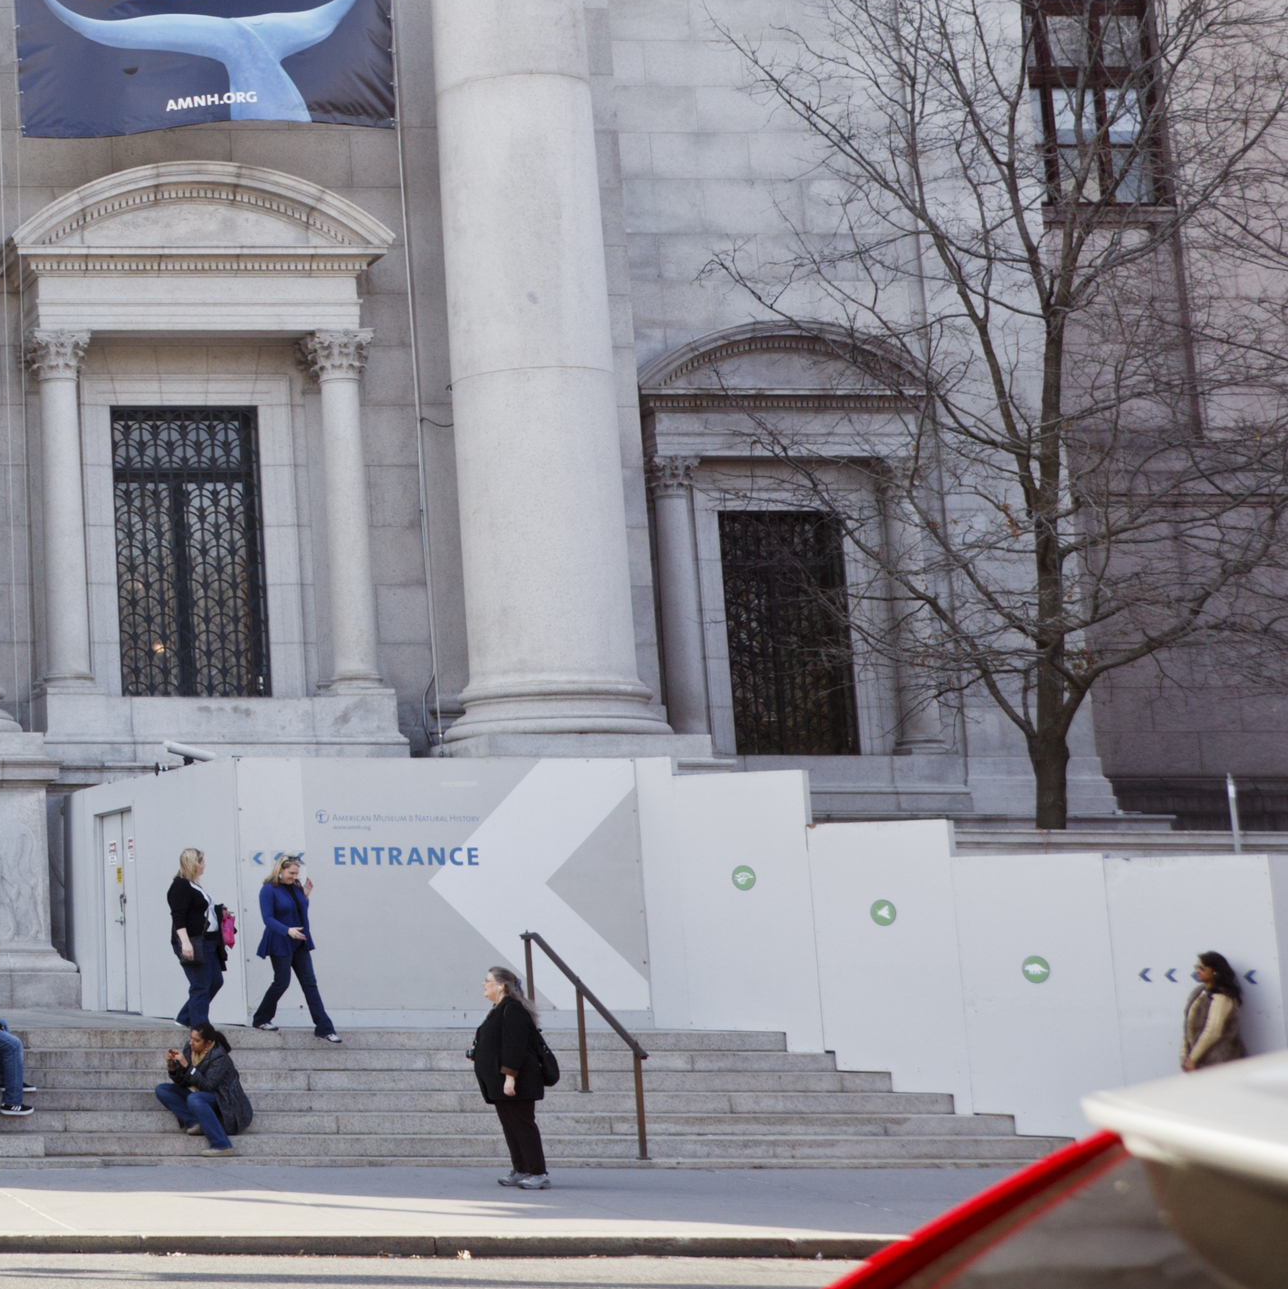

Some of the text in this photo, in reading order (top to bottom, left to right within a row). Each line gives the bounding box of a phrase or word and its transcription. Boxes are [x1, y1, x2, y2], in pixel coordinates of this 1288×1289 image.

[166, 91, 258, 112] AMNH.ORG
[332, 813, 371, 822] AMERICAN
[373, 814, 407, 822] MUSEUM
[415, 814, 448, 822] NATURAL
[449, 814, 480, 822] HISTORY
[334, 846, 480, 866] ENTRANCE
